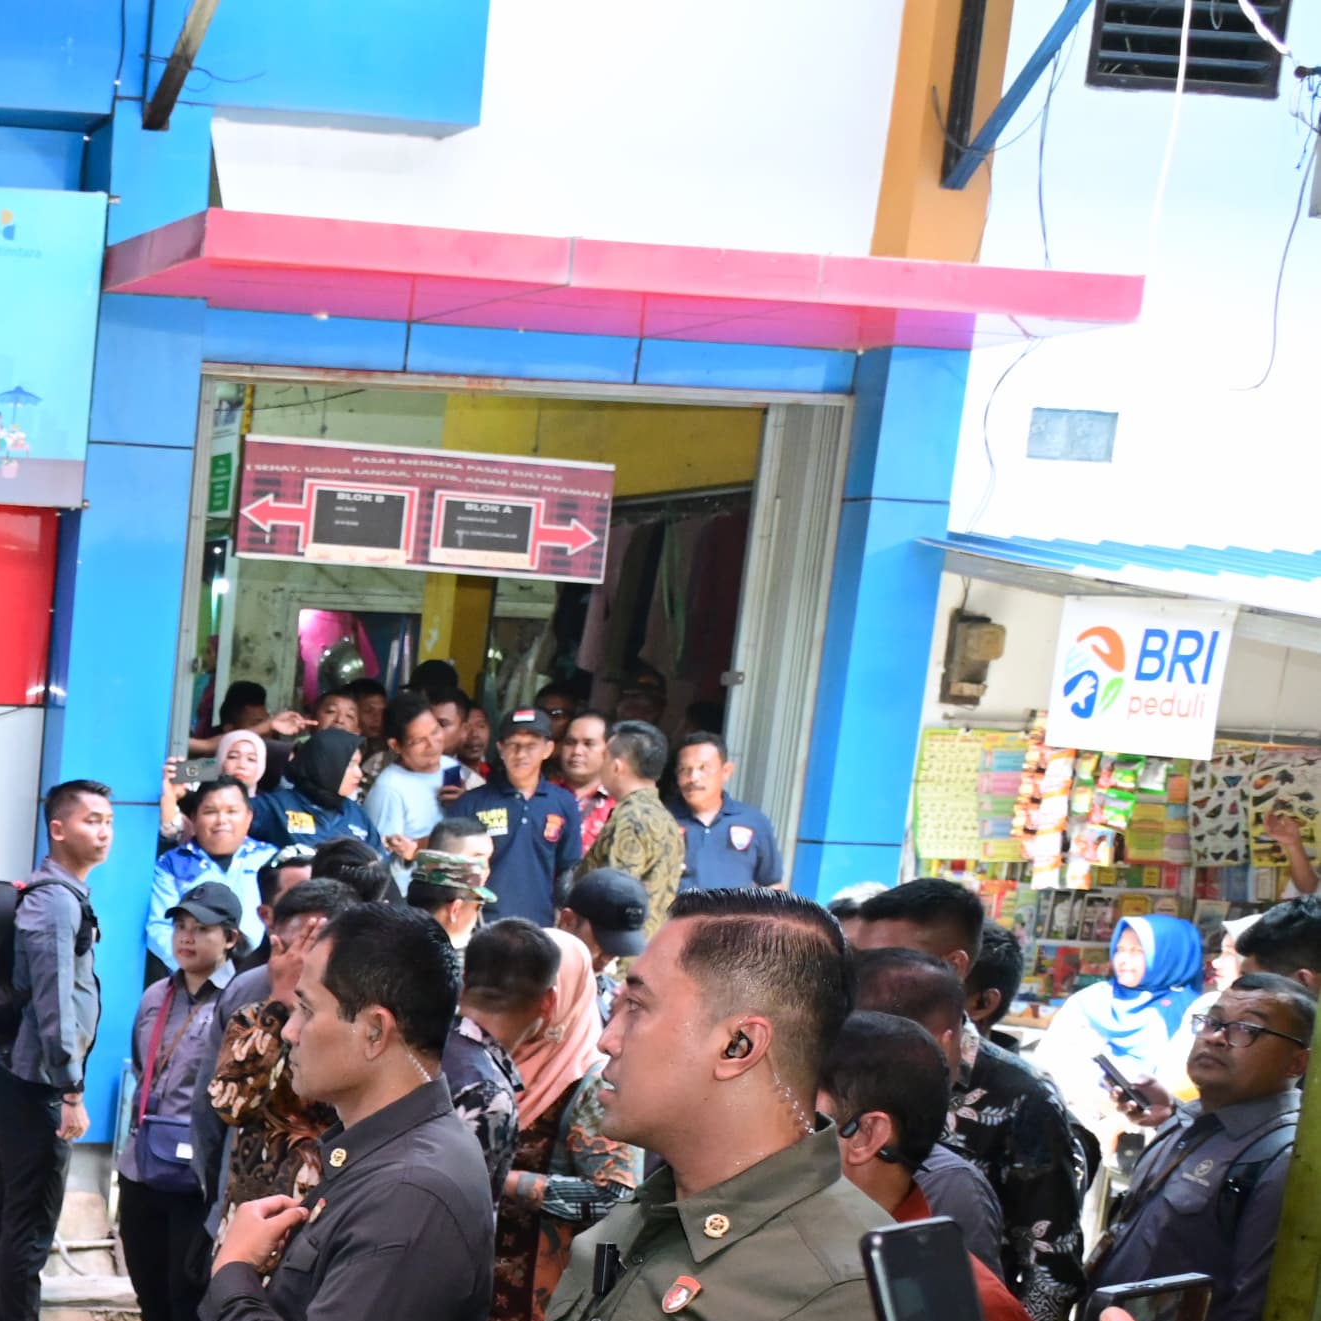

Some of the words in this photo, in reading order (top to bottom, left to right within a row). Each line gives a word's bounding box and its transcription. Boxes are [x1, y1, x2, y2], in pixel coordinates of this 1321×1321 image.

[352, 456, 397, 466] PASAR
[399, 459, 464, 471] MERDEKA
[466, 465, 510, 476] PASAR
[304, 466, 353, 476] USAHA
[464, 476, 508, 488] AMAN
[509, 481, 540, 492] DAN
[541, 485, 602, 499] NYAMAN
[336, 491, 374, 503] BLOK
[375, 494, 386, 504] B
[464, 503, 500, 514] BLOK
[501, 505, 513, 514] A
[1134, 627, 1221, 685] BRI
[1126, 691, 1207, 721] peduli
